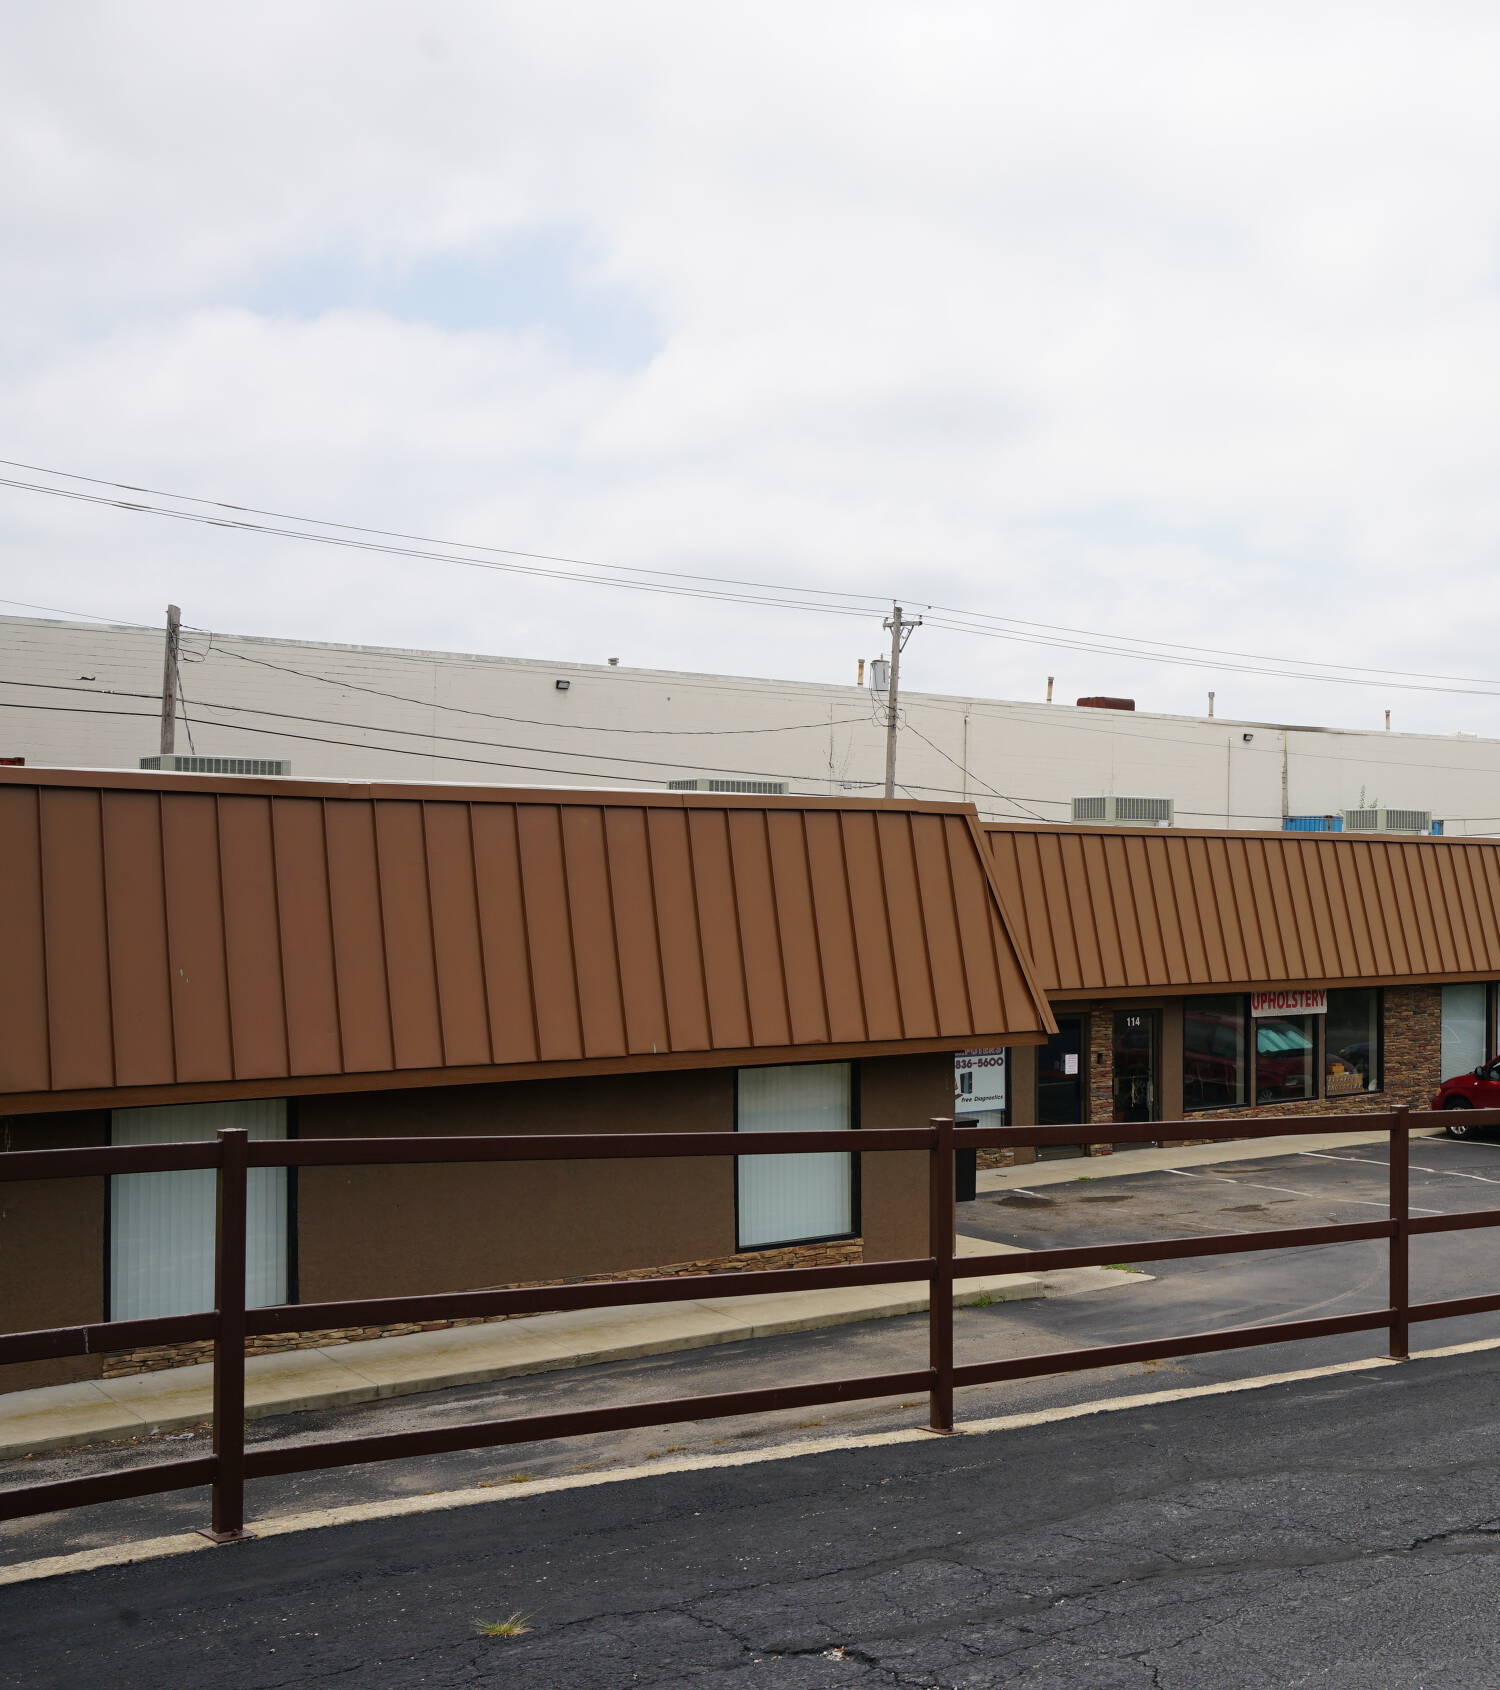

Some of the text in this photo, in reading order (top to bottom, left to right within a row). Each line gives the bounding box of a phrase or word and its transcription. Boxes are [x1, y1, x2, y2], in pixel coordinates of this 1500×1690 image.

[1251, 990, 1326, 1010] UPHOLSTERY
[1126, 1016, 1141, 1027] 114
[955, 1056, 1004, 1070] 836-5600
